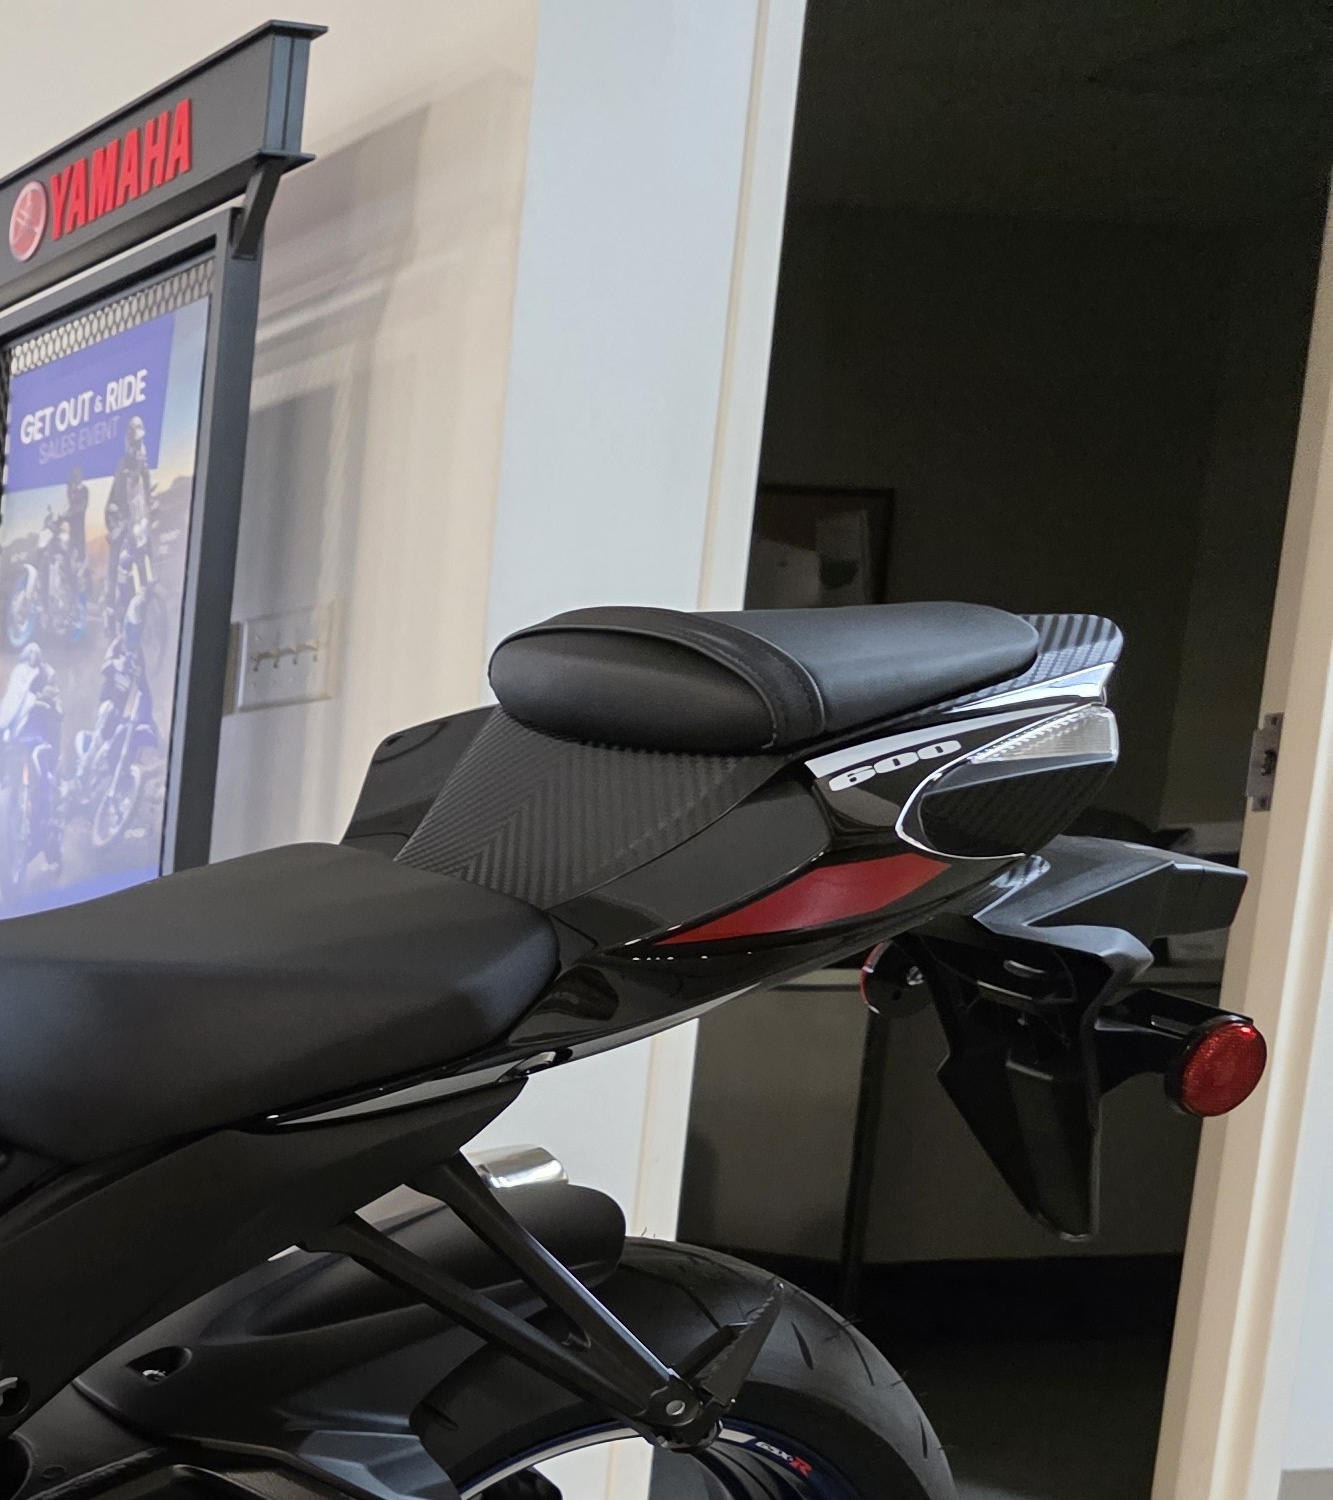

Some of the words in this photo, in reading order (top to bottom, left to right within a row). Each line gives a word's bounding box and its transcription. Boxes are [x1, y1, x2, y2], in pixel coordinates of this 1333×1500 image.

[50, 97, 192, 241] YAMAHA
[20, 406, 55, 445] GET
[55, 390, 94, 432] OUT
[105, 369, 148, 414] RIDE
[38, 431, 76, 465] SALES
[78, 415, 120, 450] EVENT
[828, 740, 962, 792] 600
